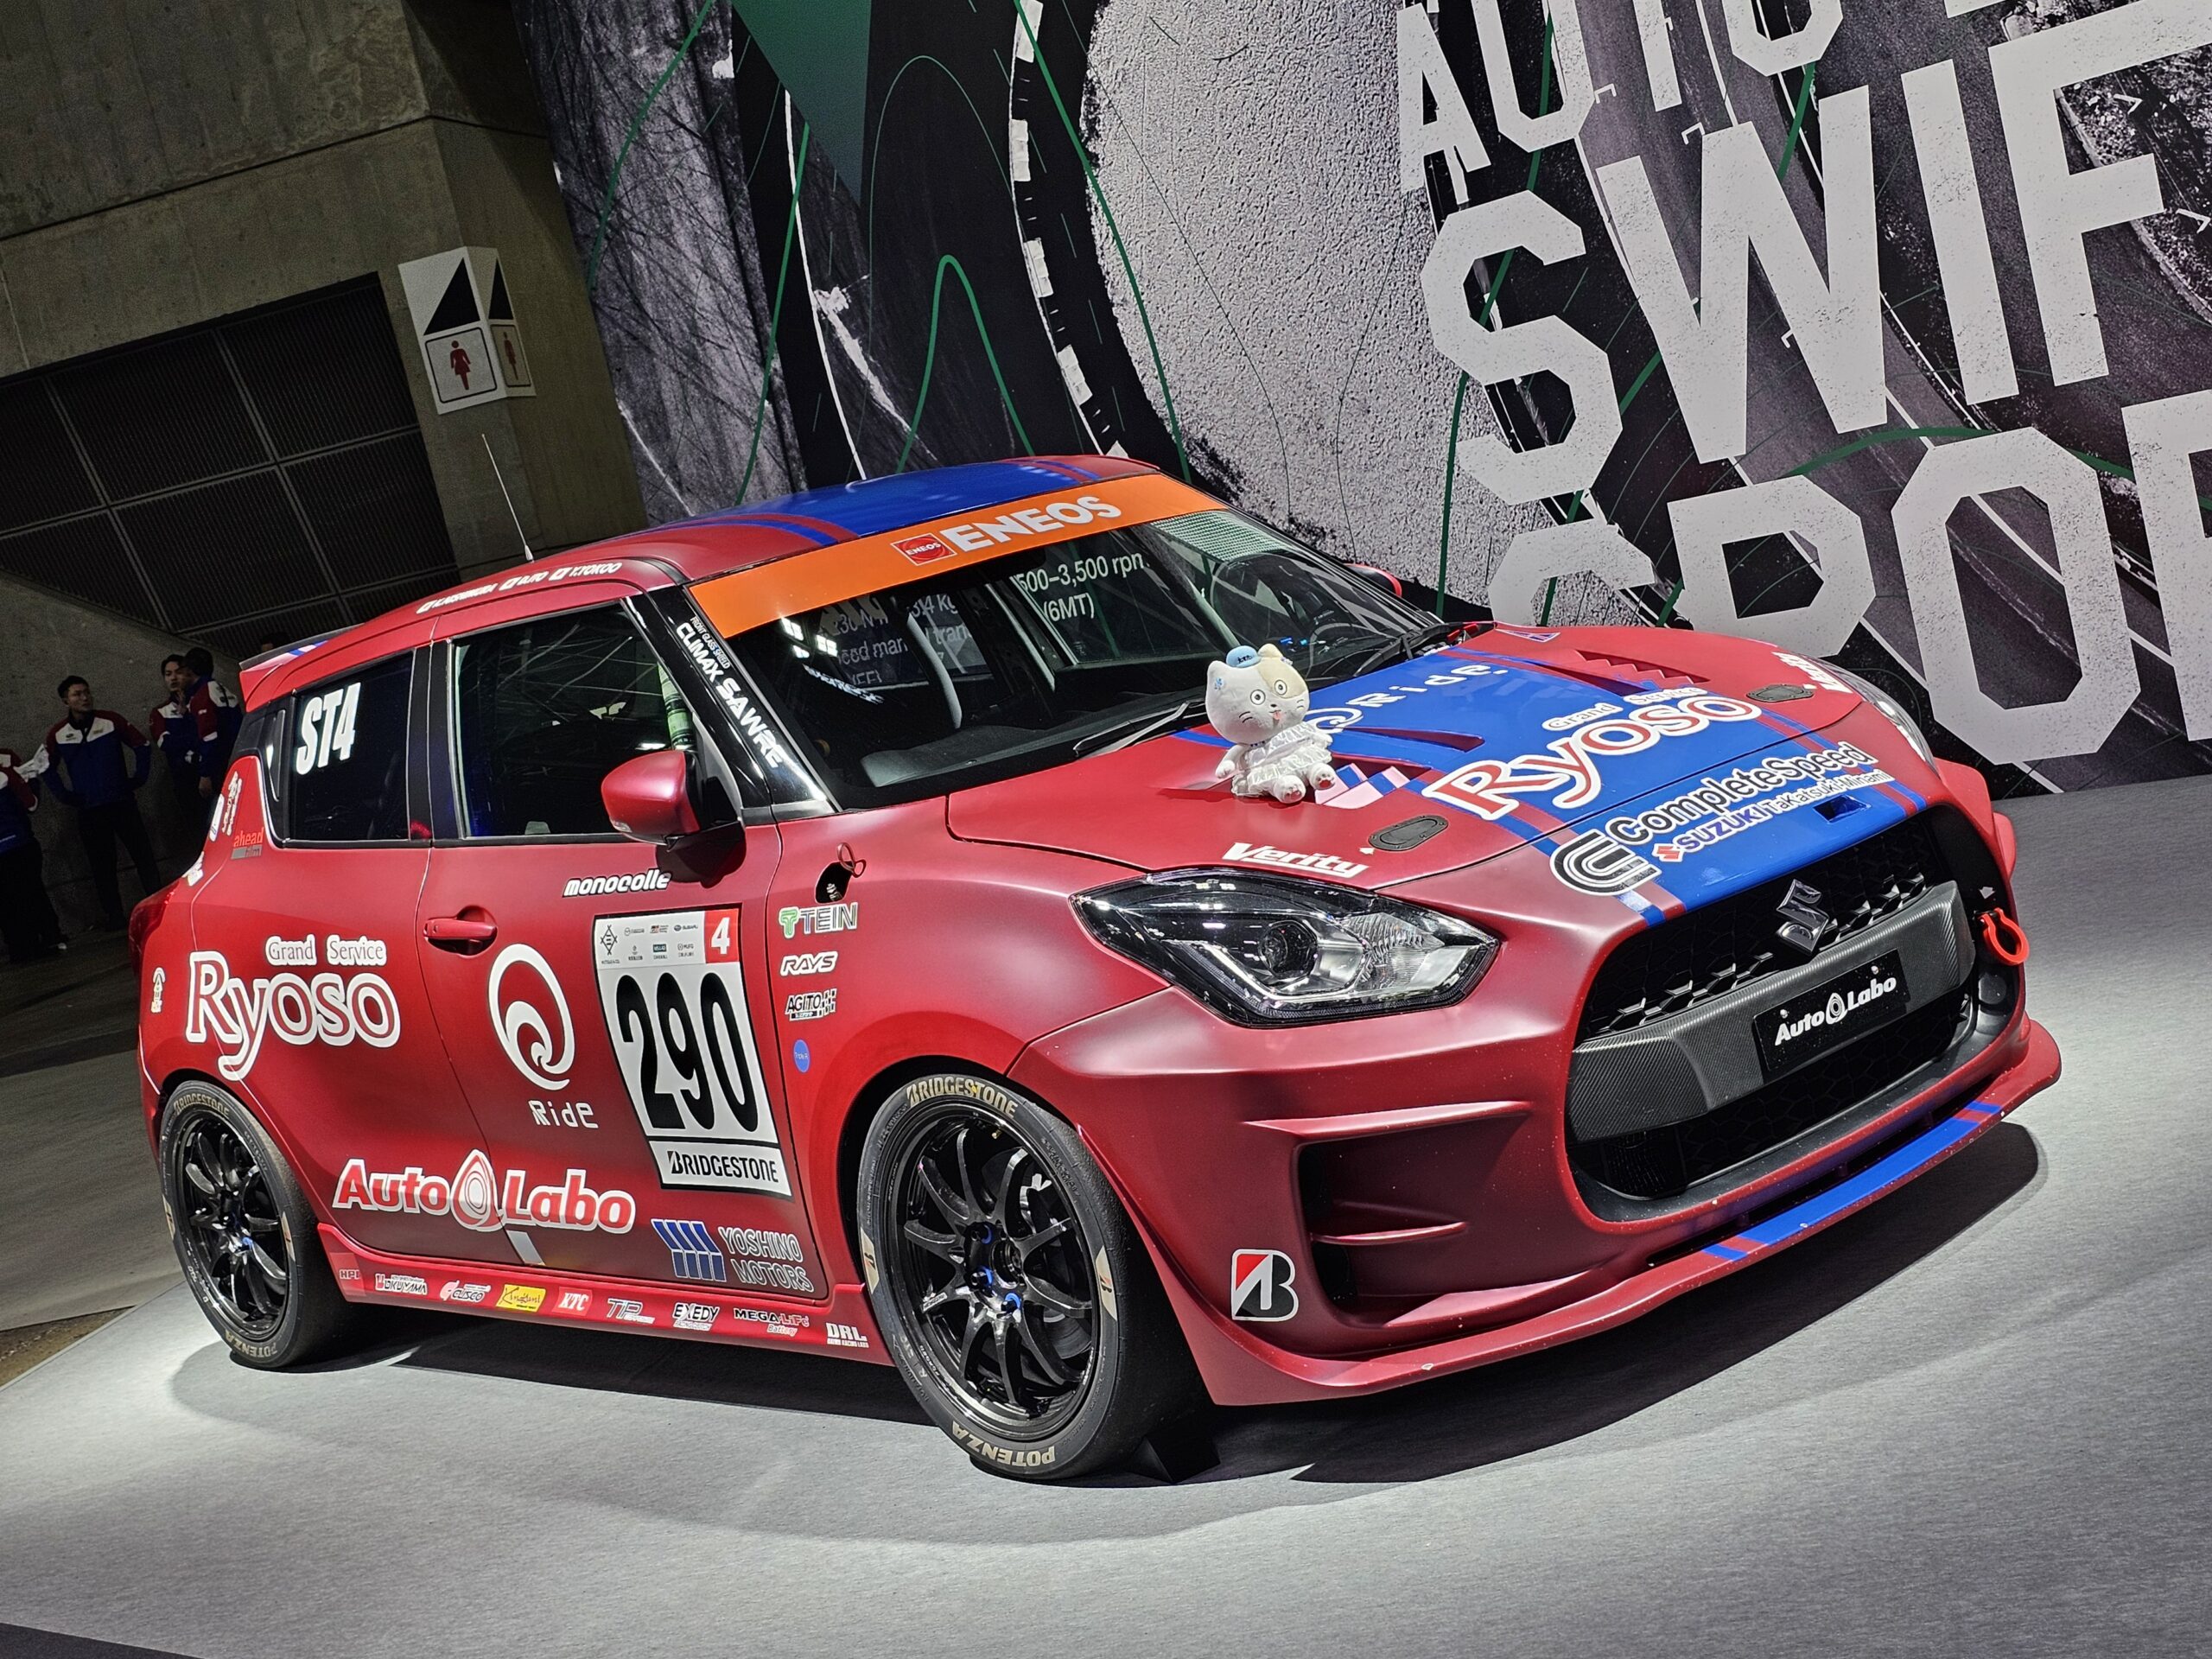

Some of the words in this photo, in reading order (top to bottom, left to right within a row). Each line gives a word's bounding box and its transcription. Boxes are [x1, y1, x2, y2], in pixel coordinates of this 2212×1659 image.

[906, 541, 942, 556] ENEOS
[939, 497, 1122, 552] ENEOS
[677, 622, 724, 683] CLIMAX
[296, 682, 361, 775] ST4
[1542, 703, 1623, 731] Grand
[1421, 696, 1762, 821] Ryoso
[233, 827, 264, 847] ahead
[1676, 805, 1765, 852] SUZUKI
[1222, 842, 1369, 878] Verity
[563, 869, 671, 897] monocolle
[801, 903, 858, 934] TEIN
[268, 937, 315, 963] Grand
[328, 937, 385, 963] Service
[711, 917, 730, 955] 4
[781, 952, 836, 975] RAYS
[187, 950, 400, 1081] Ryoso
[786, 994, 822, 1013] AGITO
[1775, 1011, 1825, 1046] Auto
[1847, 977, 1897, 1010] Labo
[616, 972, 759, 1132] 290
[174, 1093, 230, 1118] BRIDGESTONE
[906, 1077, 1019, 1118] BRIDGESTONE
[528, 1100, 599, 1128] Ride
[668, 1150, 779, 1182] BRIDGESTONE
[332, 1159, 451, 1214] Auto
[502, 1168, 636, 1234] Labo
[718, 1226, 804, 1262] YOSHINO
[731, 1259, 814, 1292] MOTORS
[451, 1289, 485, 1301] CUSCO
[558, 1293, 588, 1311] KTC
[674, 1303, 719, 1322] EXEDY
[225, 1329, 278, 1359] POTENZA
[826, 1322, 868, 1341] DRL
[952, 1421, 1056, 1466] POTENZA
